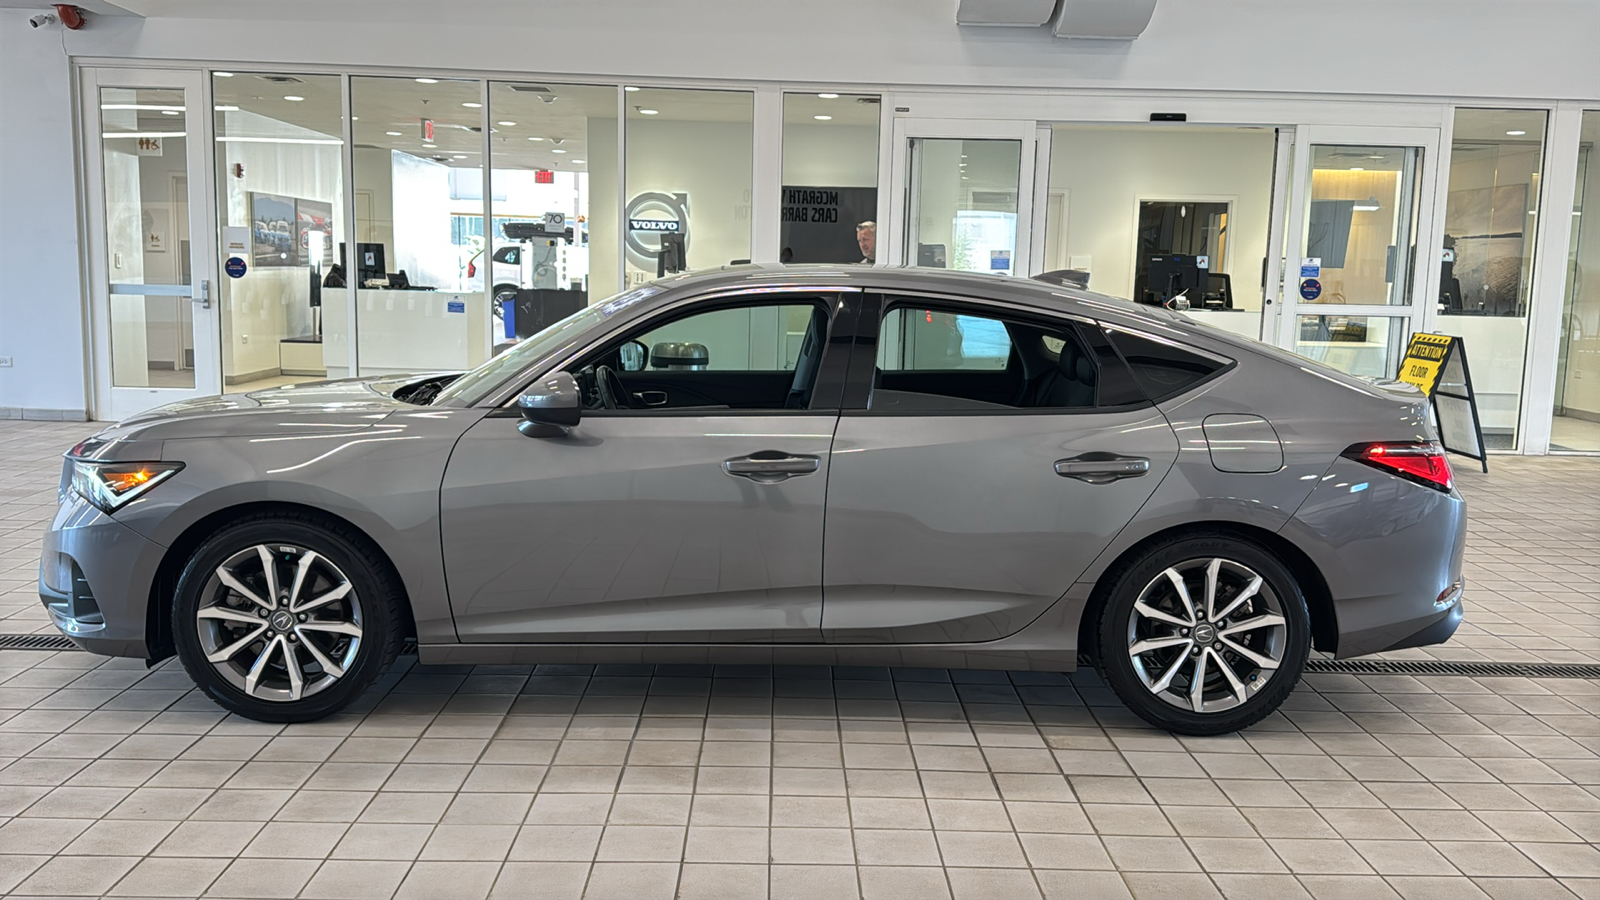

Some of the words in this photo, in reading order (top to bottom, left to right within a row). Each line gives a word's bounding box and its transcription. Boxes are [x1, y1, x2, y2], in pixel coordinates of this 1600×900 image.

[547, 214, 563, 224] 70
[631, 221, 678, 230] VOLVO
[1411, 344, 1443, 358] ATTENTION
[1409, 365, 1428, 379] FLOOR
